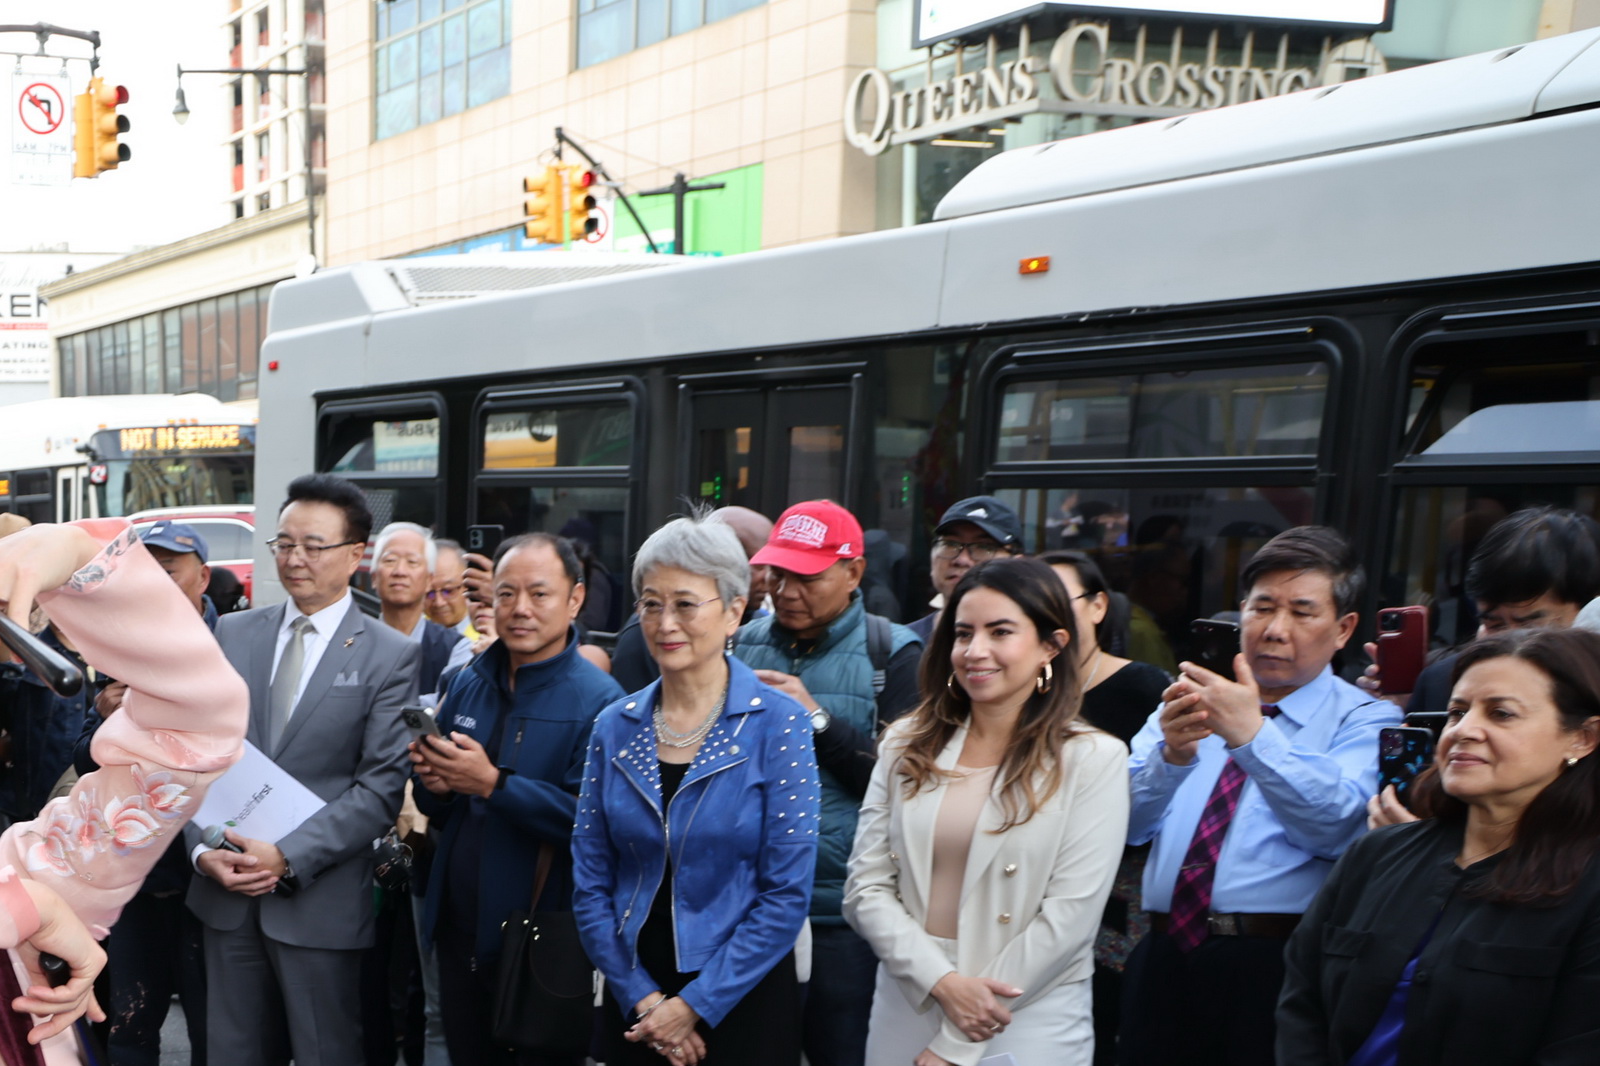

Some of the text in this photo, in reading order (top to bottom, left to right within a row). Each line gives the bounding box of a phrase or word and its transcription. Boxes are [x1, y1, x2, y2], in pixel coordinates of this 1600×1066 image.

[844, 56, 1038, 155] QUEENS
[120, 425, 240, 451] NOT IN SERVICE
